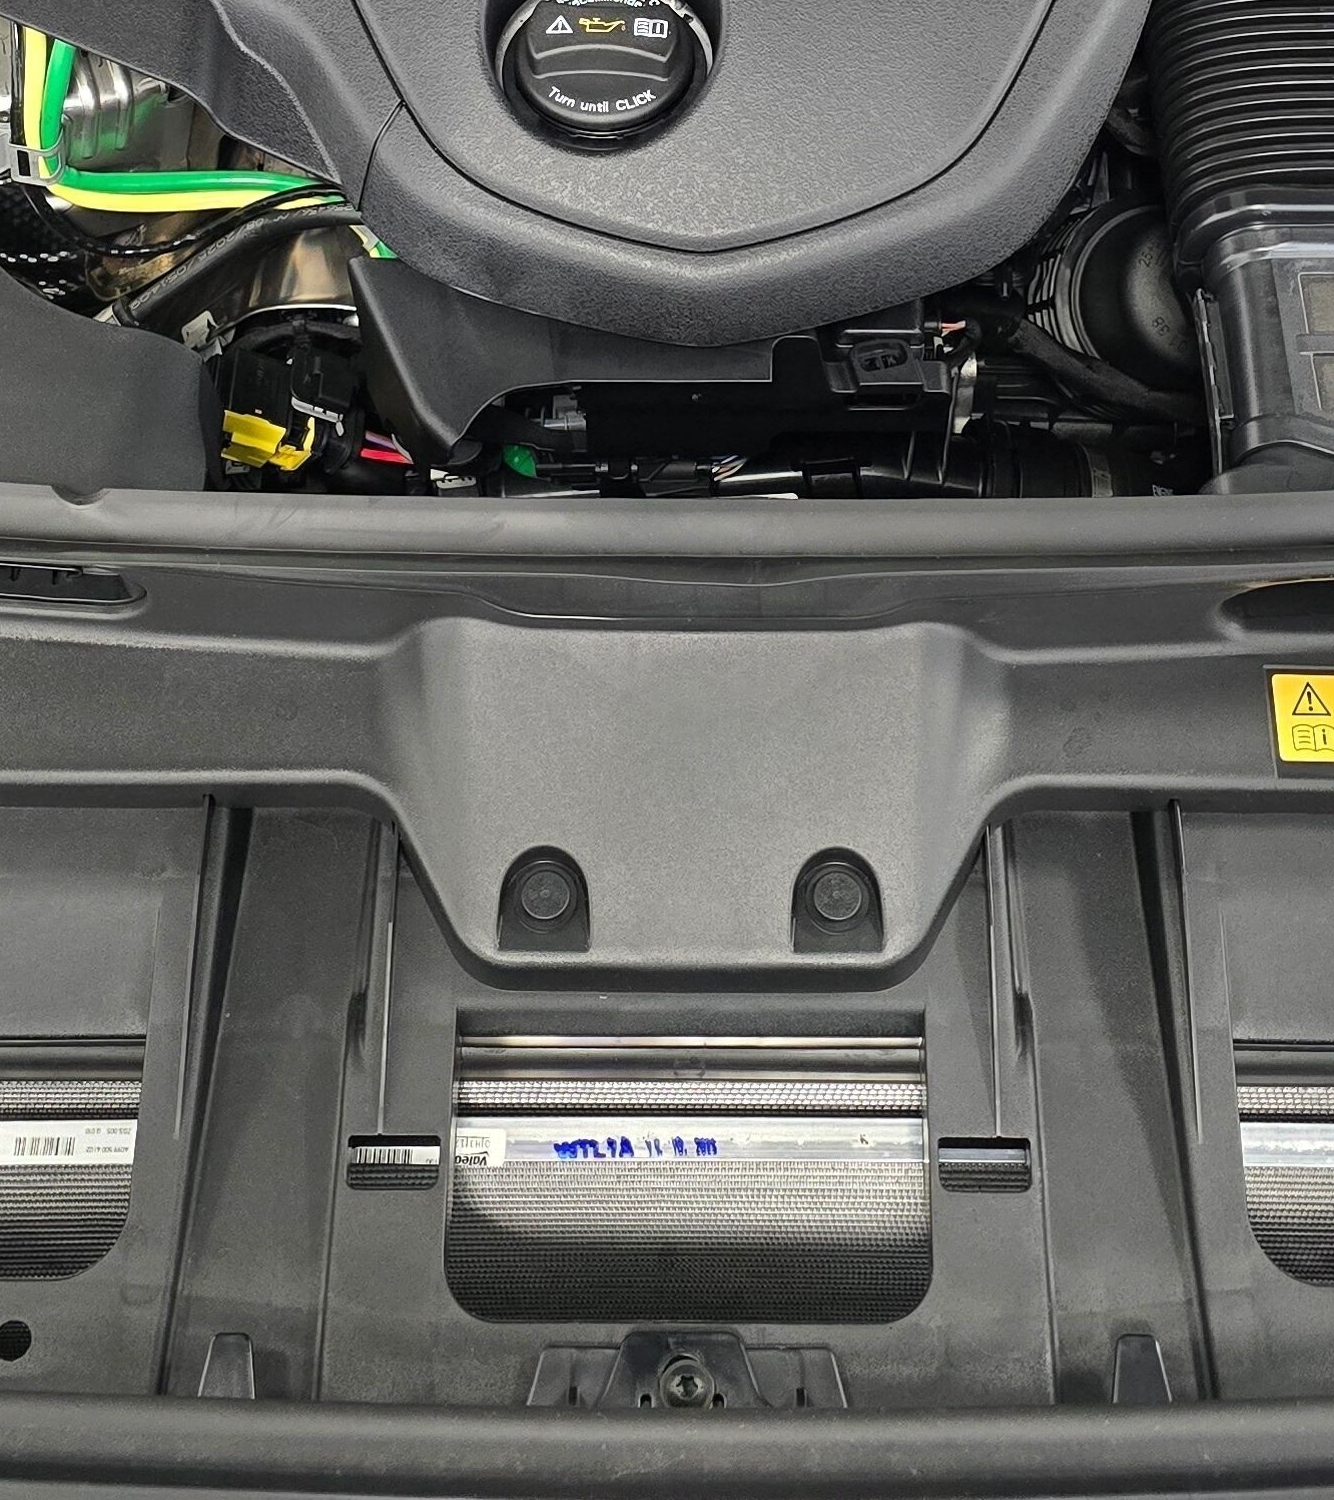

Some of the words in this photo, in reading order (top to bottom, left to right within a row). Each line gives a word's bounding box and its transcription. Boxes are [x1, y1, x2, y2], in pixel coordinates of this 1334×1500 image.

[548, 86, 576, 108] Turn
[580, 101, 609, 112] until
[616, 89, 657, 111] CLICK
